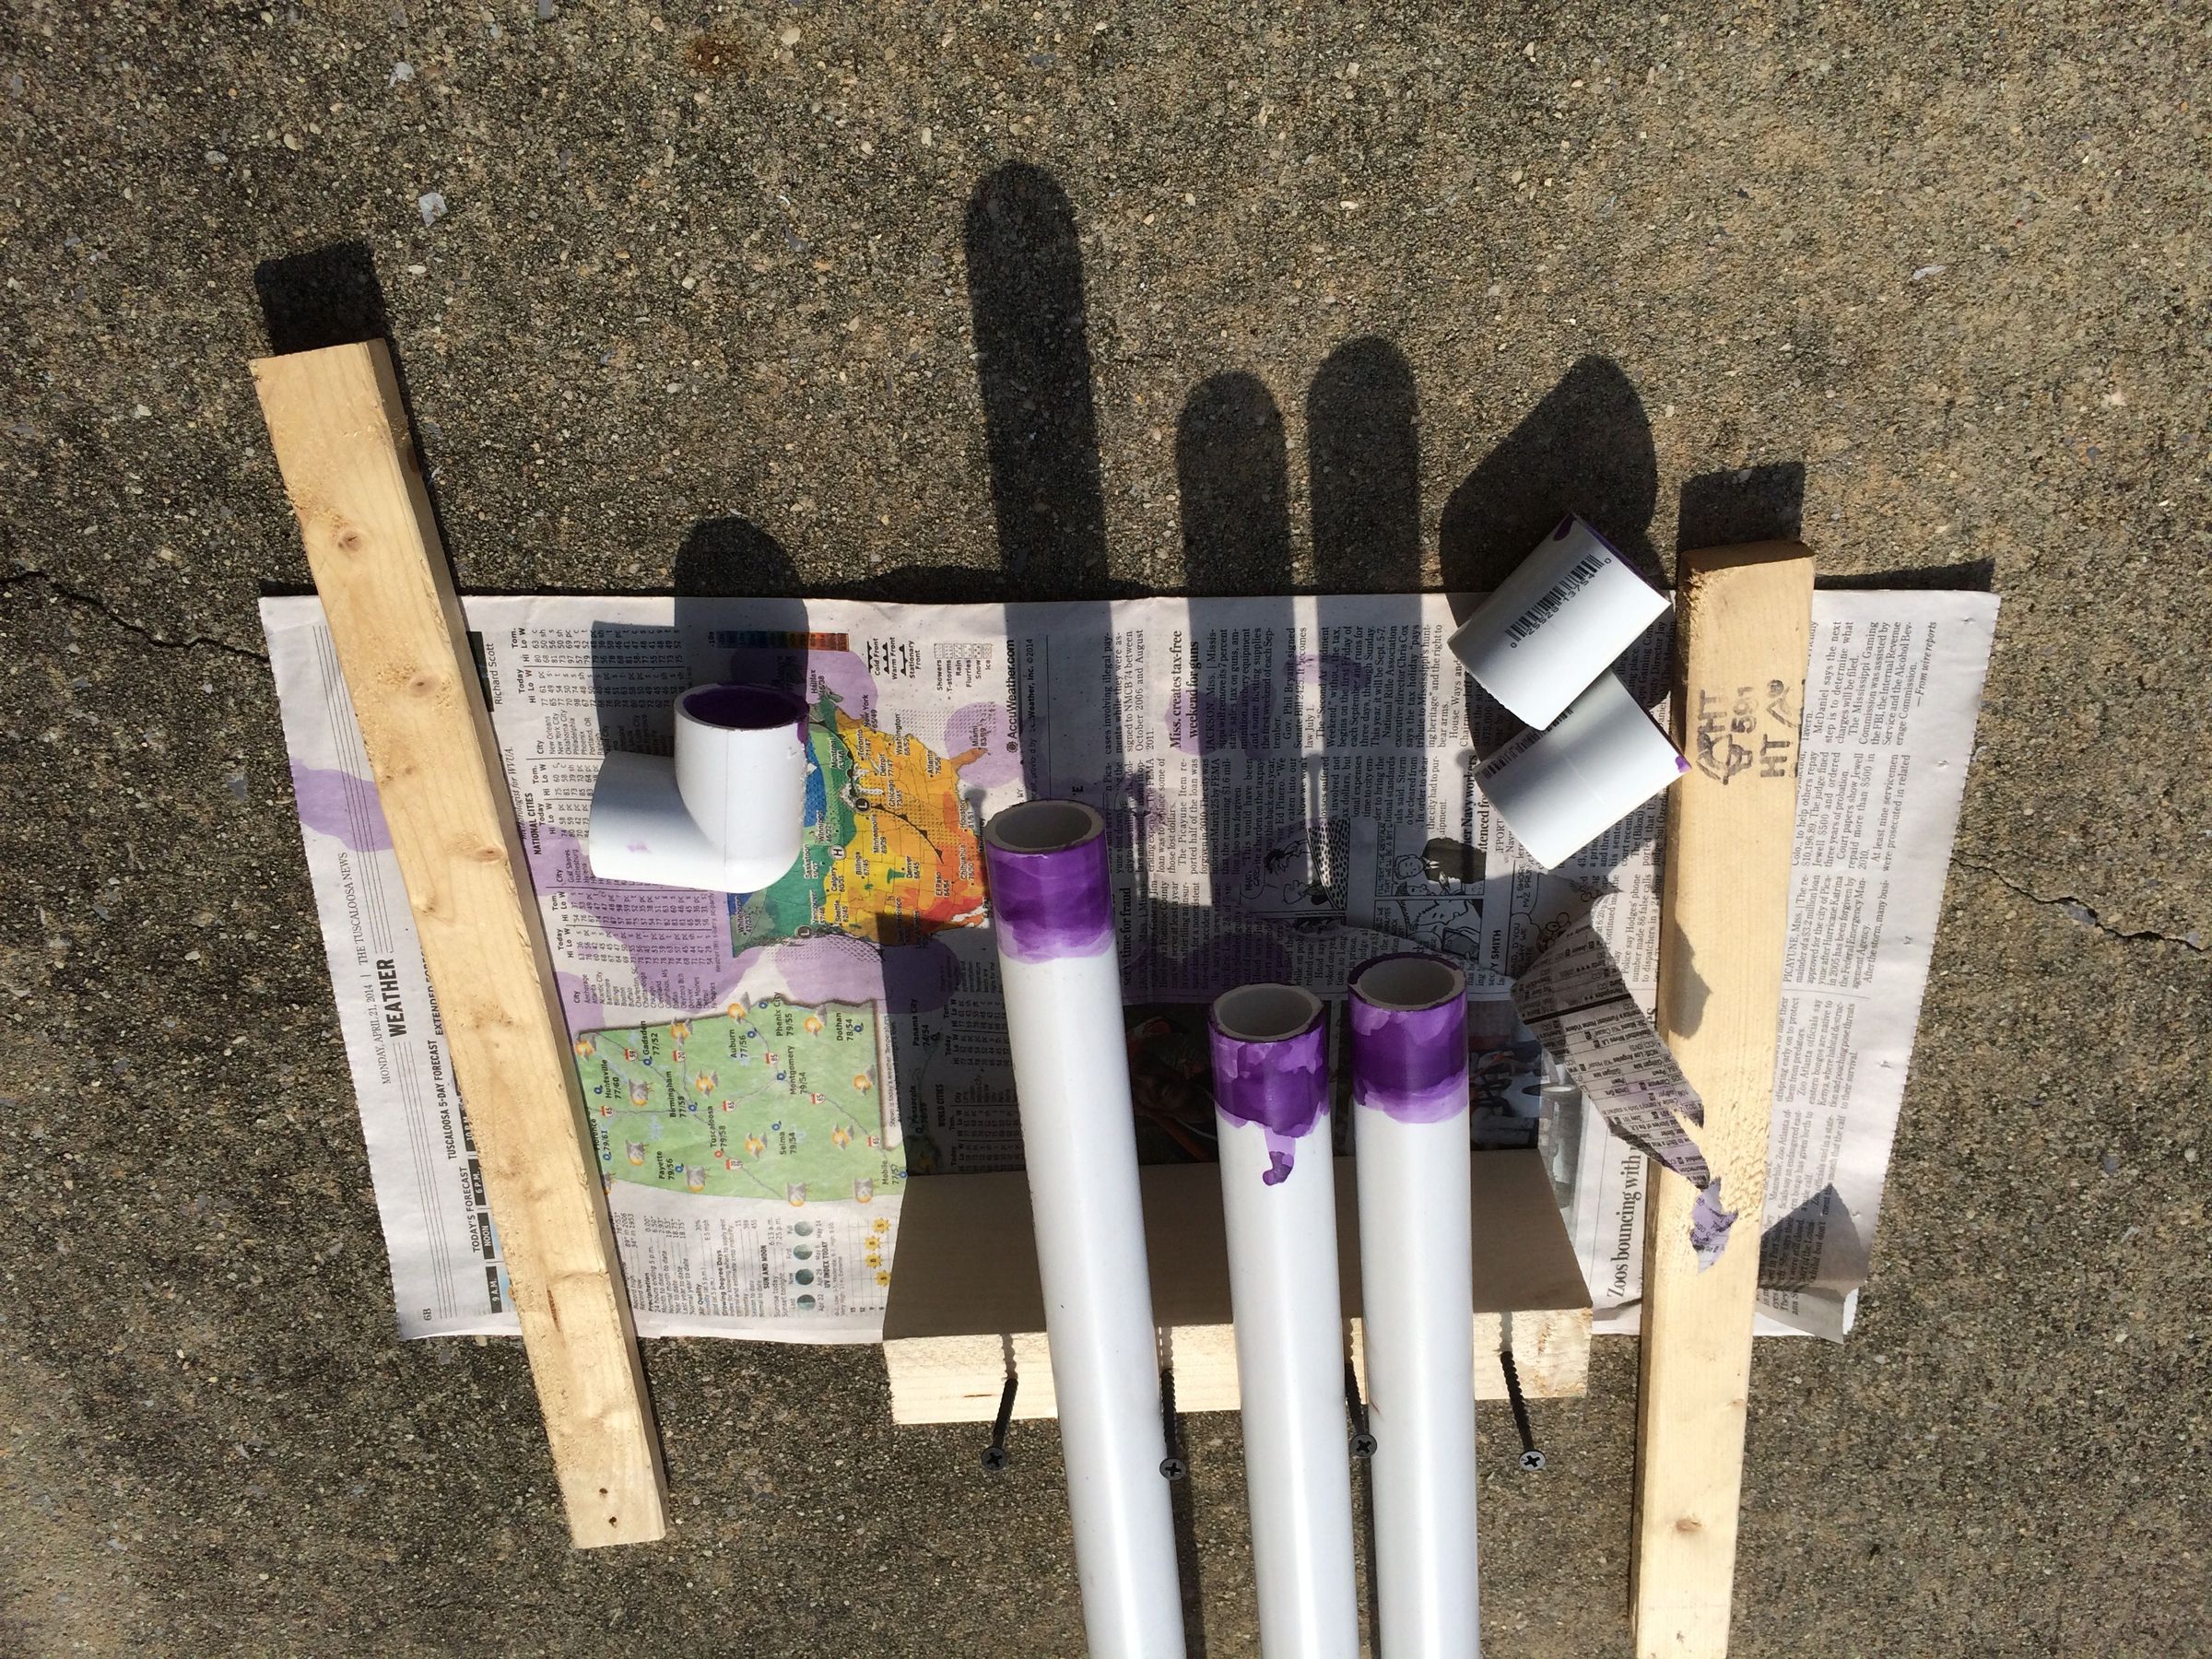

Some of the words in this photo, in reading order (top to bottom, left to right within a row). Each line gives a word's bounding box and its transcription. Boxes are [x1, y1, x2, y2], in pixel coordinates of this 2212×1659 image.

[1526, 606, 1559, 635] 25528
[1563, 573, 1594, 602] 13754
[1830, 621, 1841, 641] next
[1842, 621, 1853, 643] what
[1862, 621, 1878, 658] Gaming
[1878, 621, 1890, 632] by
[1887, 621, 1900, 658] Revenue
[487, 642, 498, 666] Scott
[908, 640, 916, 678] Stationary
[1169, 629, 1182, 674] tax-free
[1189, 641, 1201, 668] guns
[1826, 645, 1837, 660] the
[1847, 654, 1860, 677] filed.
[1873, 635, 1888, 670] assisted
[516, 668, 525, 693] Today
[1186, 669, 1198, 687] for
[1823, 665, 1833, 685] says
[1831, 648, 1848, 695] determine
[1844, 679, 1854, 689] be
[1870, 672, 1880, 688] was
[1880, 660, 1894, 694] Internal
[490, 670, 502, 704] Richard
[1005, 640, 1018, 737] AccuWeather.com
[1171, 677, 1182, 715] creates
[1841, 692, 1852, 707] will
[1852, 662, 1869, 712] Mississippi
[559, 709, 569, 723] City
[1186, 688, 1199, 737] weekend
[1813, 689, 1829, 733] McDaniel
[1830, 700, 1839, 708] to
[1877, 695, 1888, 709] the
[545, 715, 554, 739] Orleans
[553, 712, 561, 724] City
[1836, 709, 1849, 743] charges
[1847, 717, 1860, 735] The
[1858, 690, 1877, 744] Commission
[1873, 711, 1886, 729] FBI,
[536, 739, 545, 754] City
[562, 725, 572, 754] Oklahoma
[570, 717, 580, 754] Philadelphia
[579, 731, 587, 755] Phoenix
[894, 713, 903, 755] Washington
[1170, 718, 1182, 747] Miss.
[1825, 724, 1835, 743] step
[1871, 730, 1881, 744] the
[1760, 734, 1790, 777] HT
[510, 777, 521, 789] for
[1464, 754, 1479, 796] workers
[525, 792, 535, 816] CITIES
[1461, 799, 1476, 827] Navy
[528, 818, 542, 854] NATIONAL
[338, 852, 352, 880] NEWS
[344, 882, 365, 943] TUSCALOOSA
[1118, 887, 1132, 915] fraud
[1119, 918, 1132, 933] for
[355, 946, 368, 964] THE
[1120, 935, 1132, 957] time
[1491, 929, 1501, 959] SMITH
[364, 983, 375, 1002] 2014
[376, 959, 406, 1036] WEATHER
[773, 991, 782, 1006] City
[369, 1004, 378, 1016] 21,
[775, 1009, 783, 1036] Phenix
[371, 1018, 383, 1042] APRIL
[641, 1020, 650, 1054] Gadsden
[729, 1029, 737, 1057] Auburn
[428, 1040, 443, 1080] FORECAST
[739, 1035, 747, 1057] 77/56
[376, 1044, 391, 1083] MONDAY,
[787, 1045, 797, 1094] Montgomery
[601, 1059, 612, 1098] Huntsville
[613, 1077, 621, 1099] 77/60
[435, 1083, 448, 1106] 5-DAY
[665, 1071, 677, 1117] Birmingham
[440, 1109, 457, 1159] TUSCALOOSA
[591, 1118, 600, 1150] Florence
[601, 1130, 610, 1150] 79/61
[707, 1105, 717, 1147] Tuscaloosa
[656, 1150, 665, 1179] Fayette
[1620, 1154, 1641, 1189] with
[460, 1166, 474, 1211] FORECAST
[467, 1215, 480, 1252] TODAY'S
[482, 1225, 491, 1246] NOON
[1610, 1191, 1641, 1261] bouncing
[759, 1244, 768, 1255] MOON
[490, 1278, 499, 1294] A.M.
[824, 1279, 830, 1288] UV
[1606, 1264, 1628, 1297] Zoos
[423, 1308, 432, 1320] 6B
